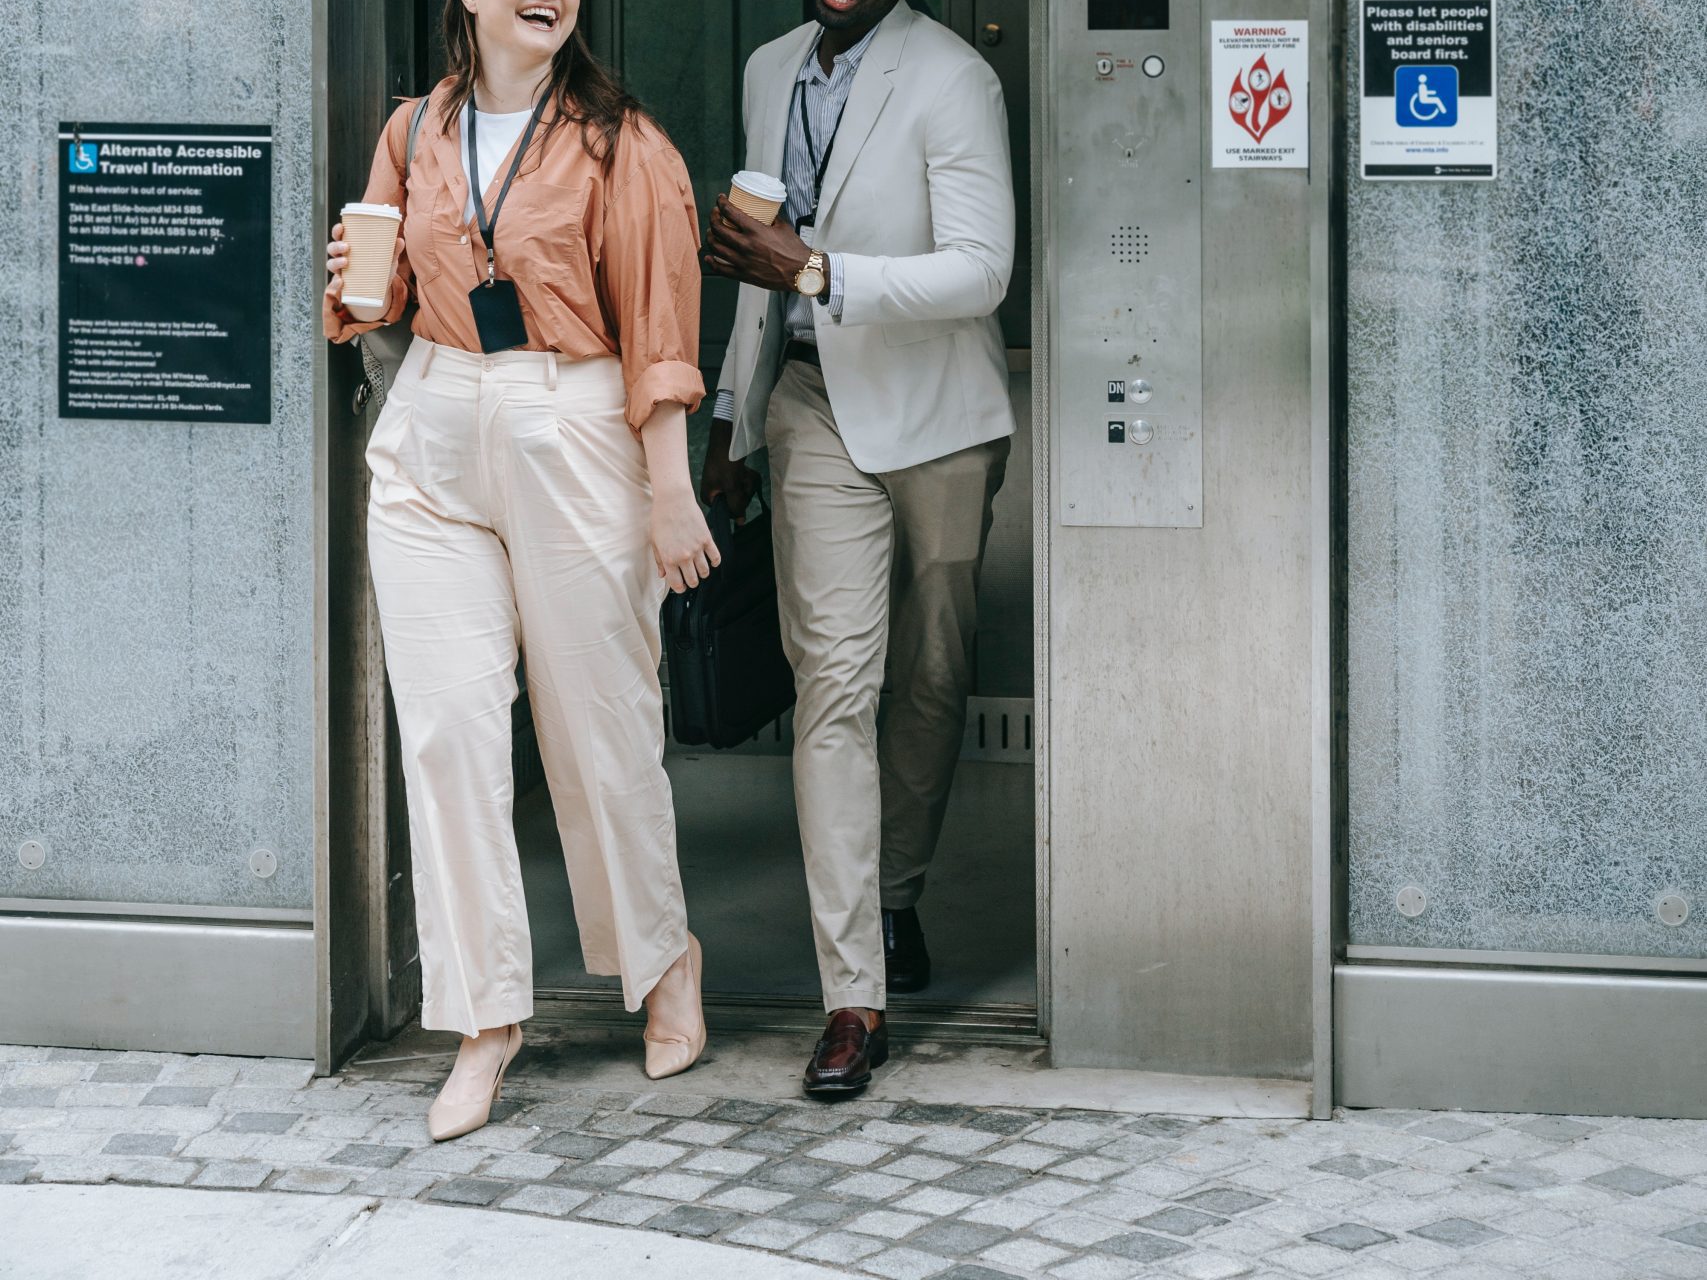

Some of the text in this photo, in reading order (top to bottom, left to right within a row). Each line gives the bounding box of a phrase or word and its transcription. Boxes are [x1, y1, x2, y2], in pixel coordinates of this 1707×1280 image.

[1367, 7, 1488, 19] Please let people
[1372, 21, 1483, 31] with disabilities
[1234, 28, 1286, 36] WARNING
[1387, 35, 1468, 45] and seniors
[1391, 49, 1468, 59] board first.
[99, 144, 262, 159] Alternate Accessible
[99, 161, 243, 176] Travel Information
[69, 185, 202, 196] If this elevator is out of service:
[69, 204, 202, 214] Take East Side-bound M34 SBS
[85, 216, 94, 224] St
[96, 216, 111, 224] and
[113, 216, 122, 225] 11
[140, 217, 149, 225] to
[159, 217, 169, 225] Av
[171, 217, 188, 226] and
[190, 218, 223, 226] transfer
[69, 226, 78, 234] to
[80, 226, 90, 234] an
[92, 226, 110, 234] M20
[112, 227, 127, 235] bus
[130, 227, 139, 235] or
[167, 228, 186, 236] SBS
[188, 228, 196, 236] to
[199, 228, 208, 236] 41
[69, 244, 90, 253] Then
[93, 244, 127, 254] proceed
[130, 245, 138, 253] to
[140, 245, 150, 254] 42
[152, 245, 162, 254] St
[164, 246, 179, 254] and
[190, 246, 201, 255] Av
[69, 255, 95, 264] Times
[124, 256, 133, 265] St
[1109, 382, 1124, 394] DN
